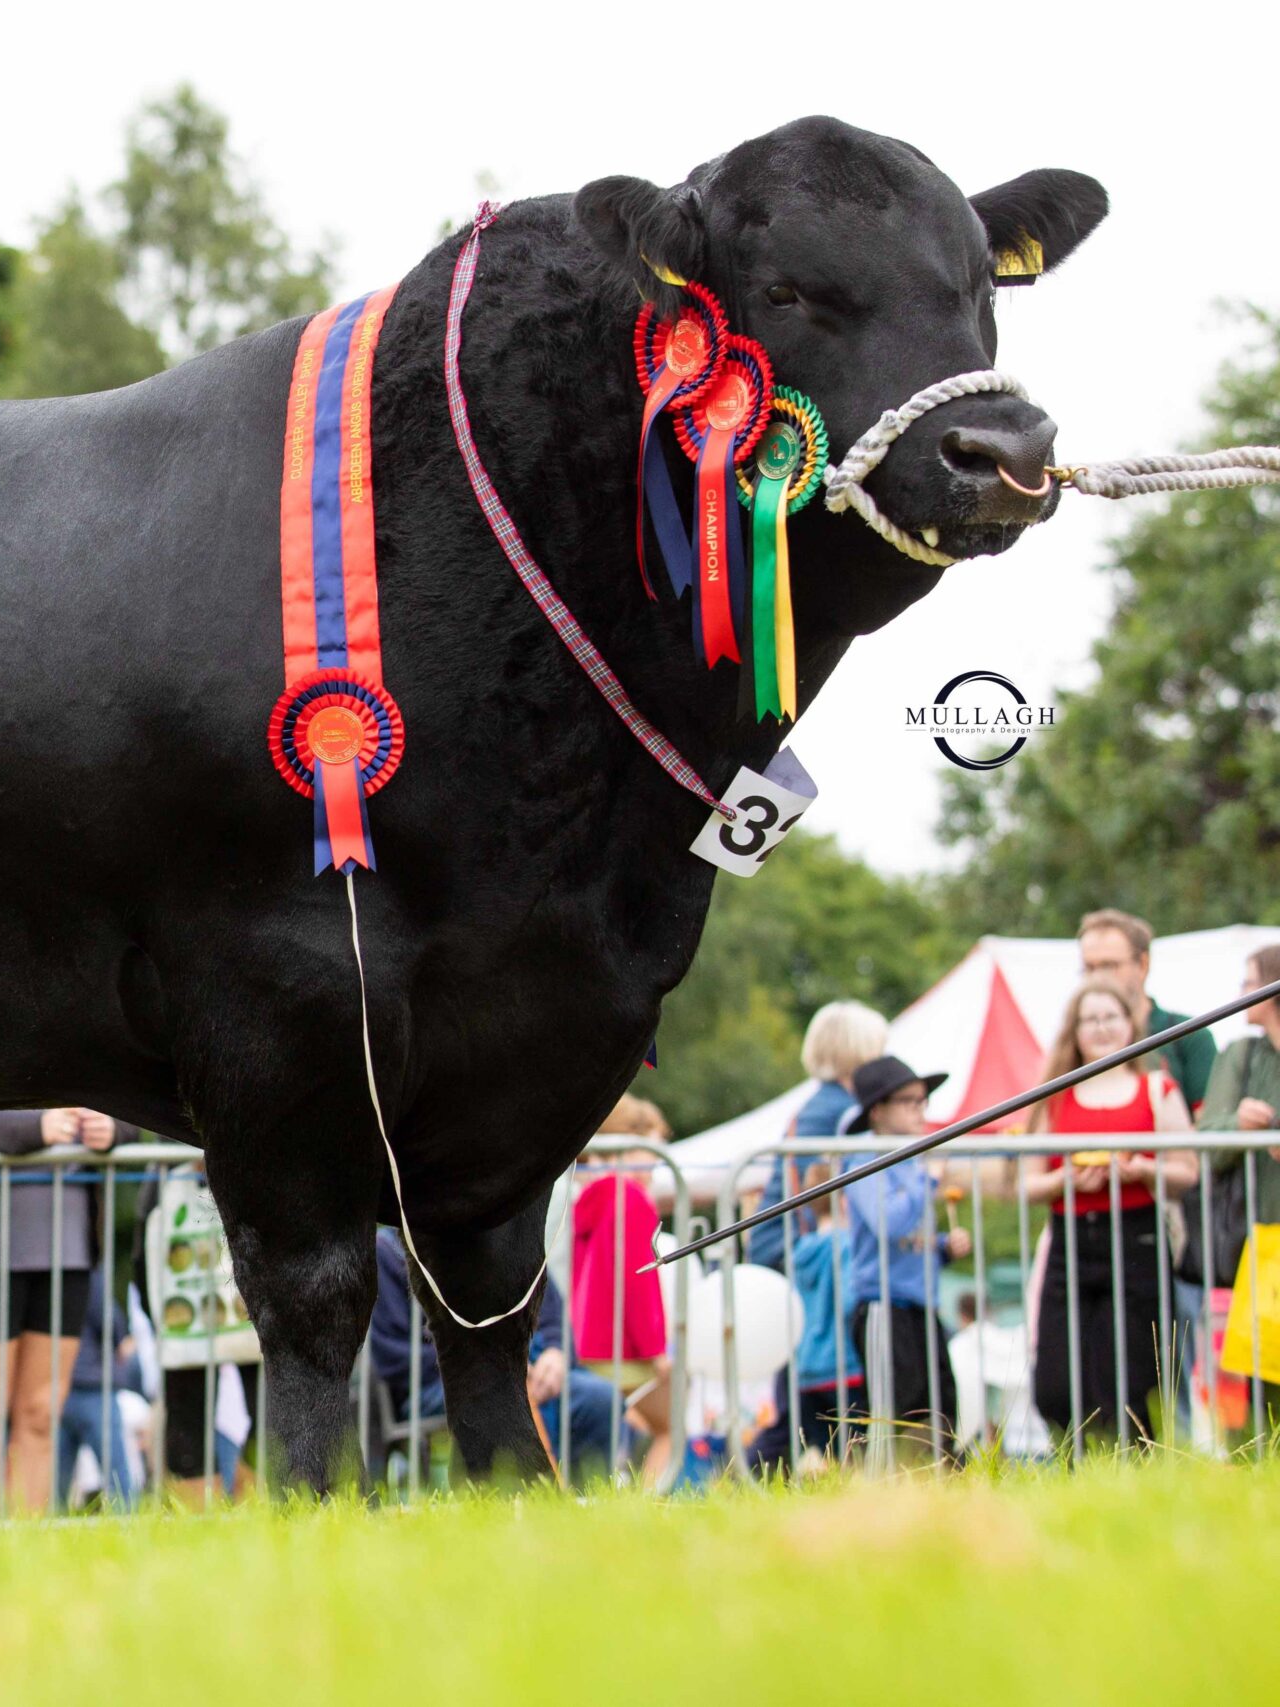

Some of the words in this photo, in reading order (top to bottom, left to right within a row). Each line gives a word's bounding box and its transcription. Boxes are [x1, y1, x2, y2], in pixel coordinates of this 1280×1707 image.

[352, 355, 368, 397] OVERALL
[295, 384, 308, 423] VALLEY
[350, 402, 362, 440] ANGUS
[290, 425, 305, 480] CLOGHER
[351, 444, 363, 504] ABERDEEN
[706, 489, 719, 583] CHAMPION
